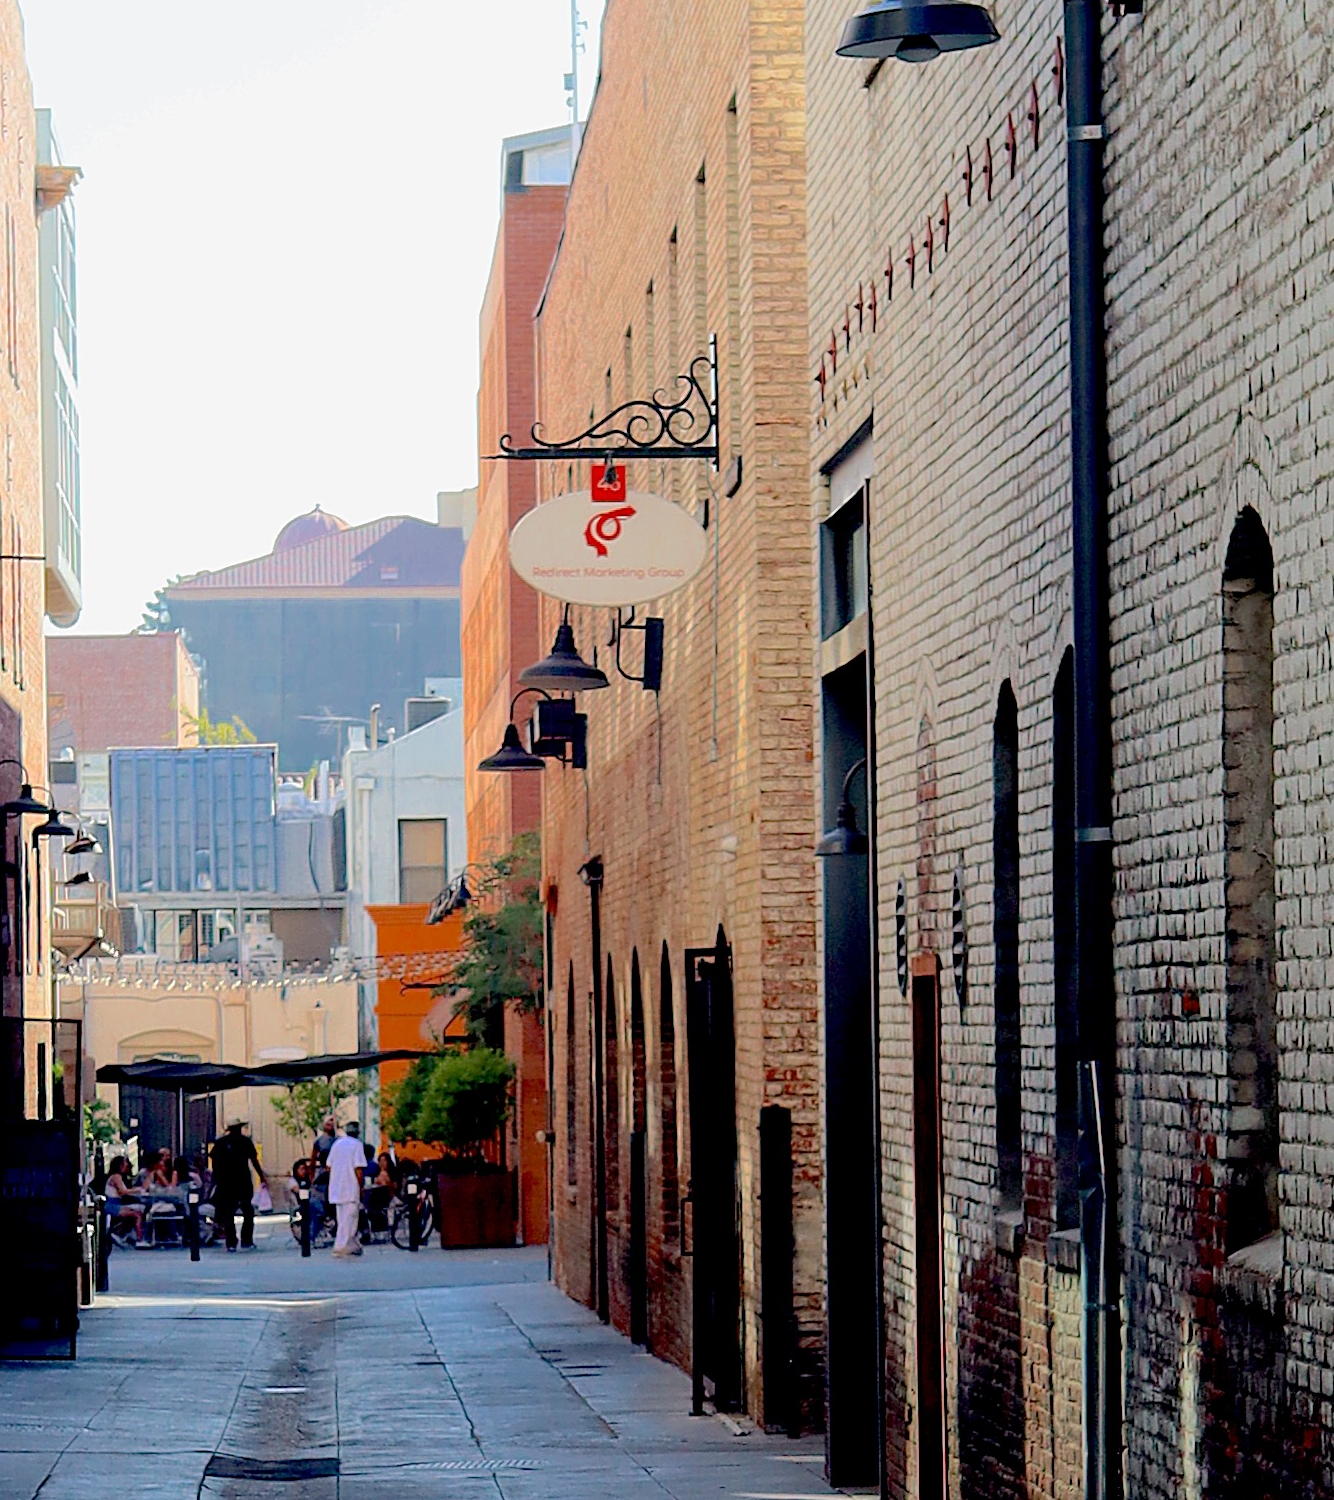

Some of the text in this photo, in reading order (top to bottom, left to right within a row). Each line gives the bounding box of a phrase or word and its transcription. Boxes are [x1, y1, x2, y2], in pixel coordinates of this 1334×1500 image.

[532, 566, 684, 580] Redirect Marketing Group
